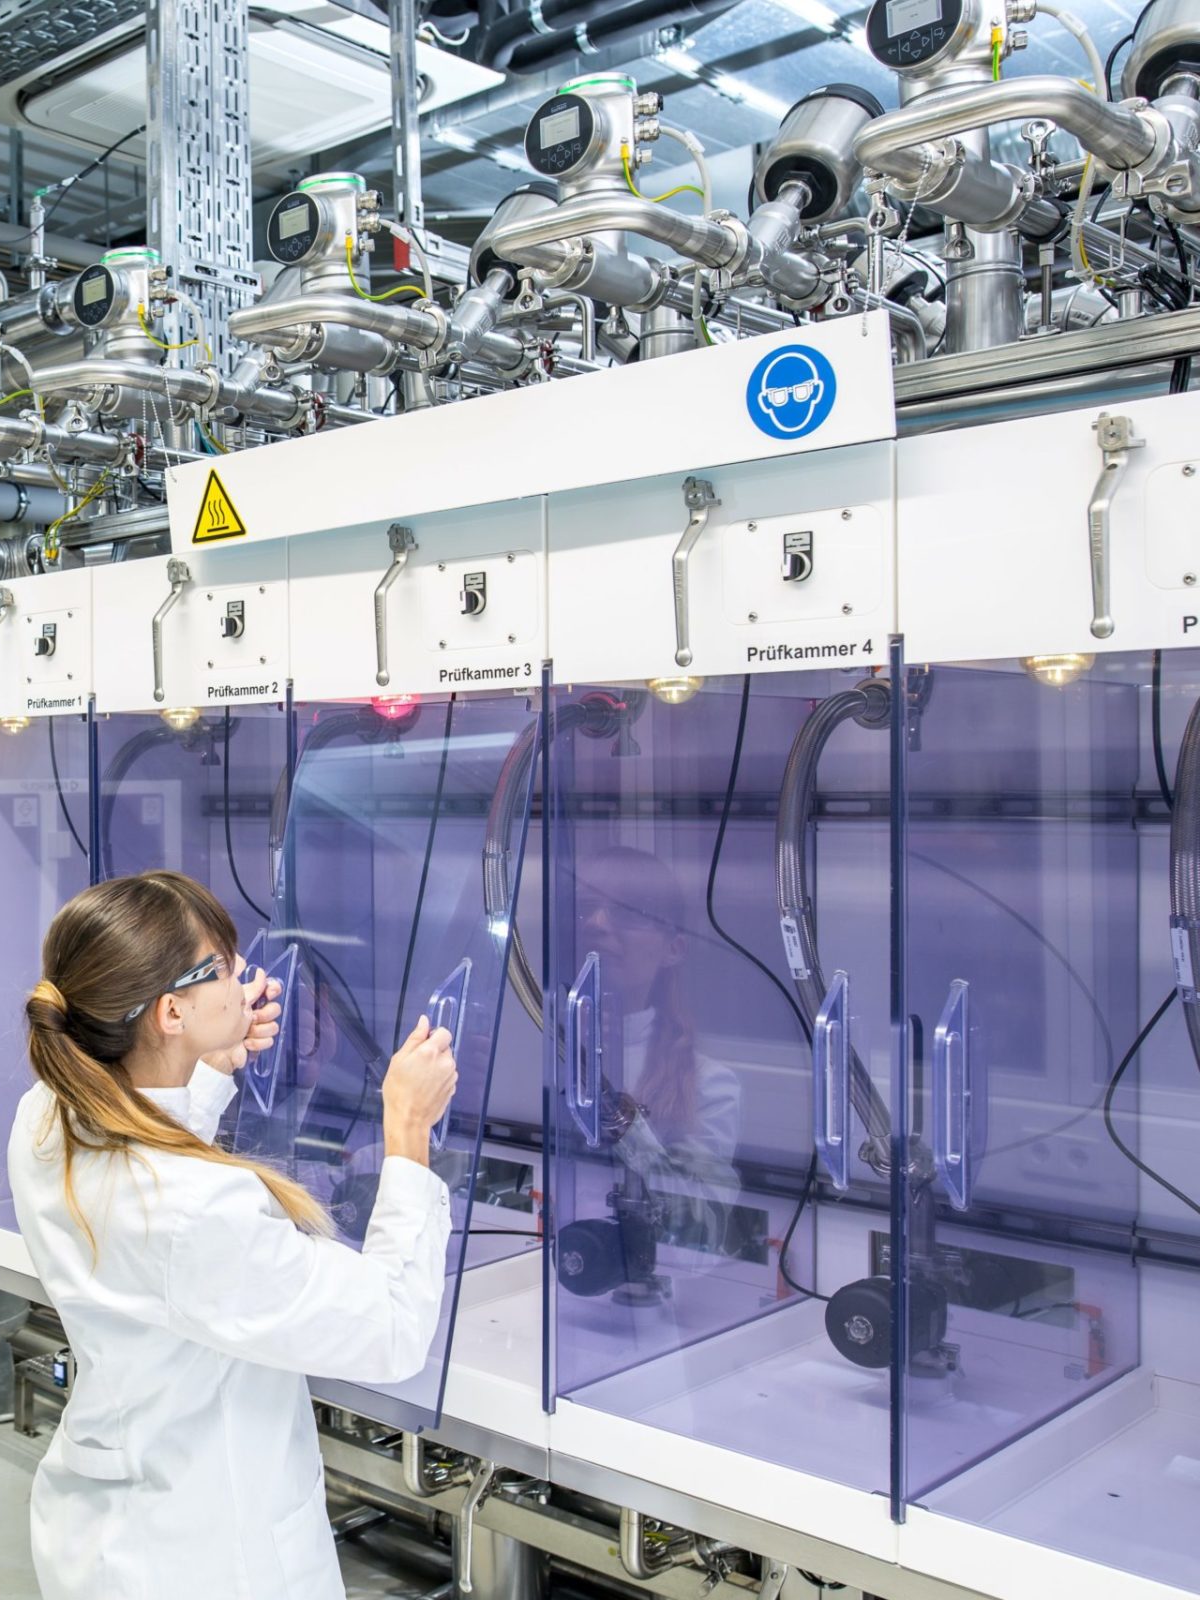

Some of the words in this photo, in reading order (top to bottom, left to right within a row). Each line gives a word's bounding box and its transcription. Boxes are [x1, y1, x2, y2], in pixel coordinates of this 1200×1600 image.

[746, 643, 857, 662] Prüfkammer
[862, 639, 873, 655] 4
[439, 666, 520, 682] Prüfkammer
[524, 662, 532, 676] 3
[207, 685, 269, 698] Prüfkammer
[271, 681, 278, 694] 2
[27, 697, 76, 709] Prüfkammer
[77, 695, 82, 706] 1
